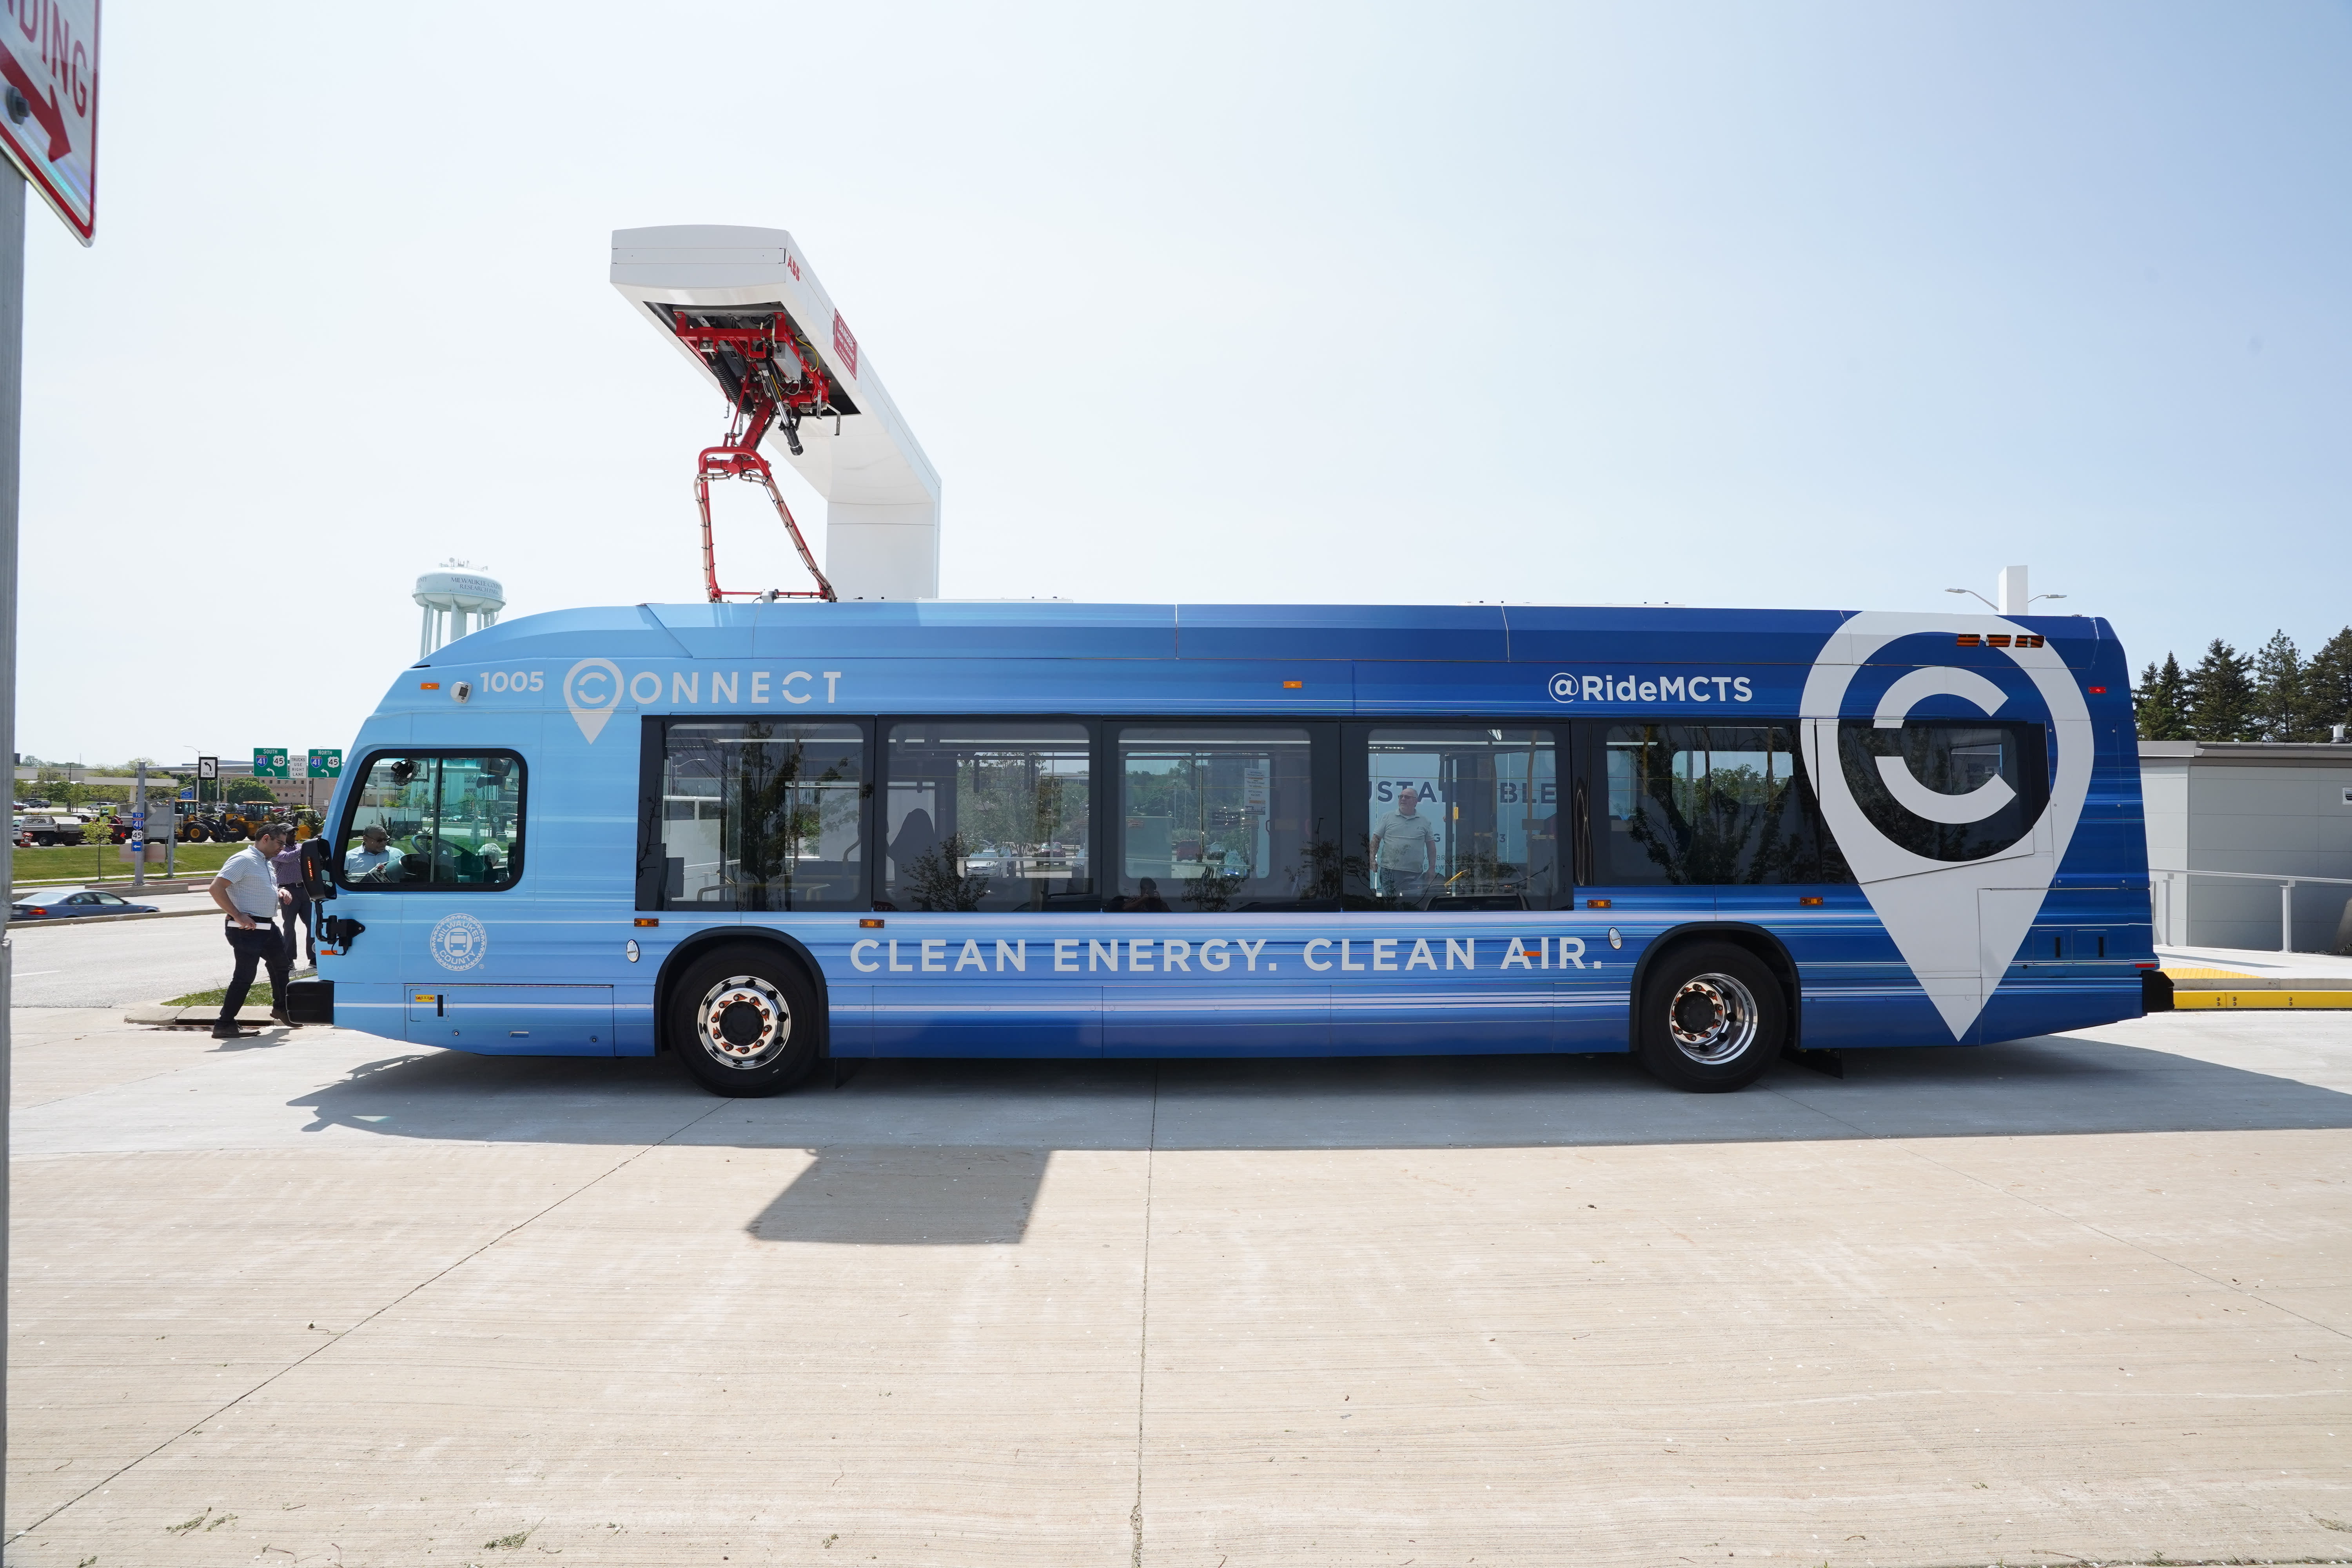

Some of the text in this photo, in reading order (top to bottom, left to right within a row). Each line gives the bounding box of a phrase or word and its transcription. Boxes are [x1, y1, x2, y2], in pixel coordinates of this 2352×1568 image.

[7, 0, 87, 118] DING
[788, 255, 799, 281] ABB
[844, 341, 855, 361] VOLTAGE
[451, 577, 486, 586] MILWAUKEE
[460, 584, 488, 592] RESEARCH
[480, 671, 544, 692] 1005
[1548, 672, 1752, 703] @RideMCTS
[437, 921, 480, 942] MILWAUKEE
[439, 950, 475, 964] COUNTY
[850, 937, 1601, 973] CLEAN ENERGY. CLEAN AIR.
